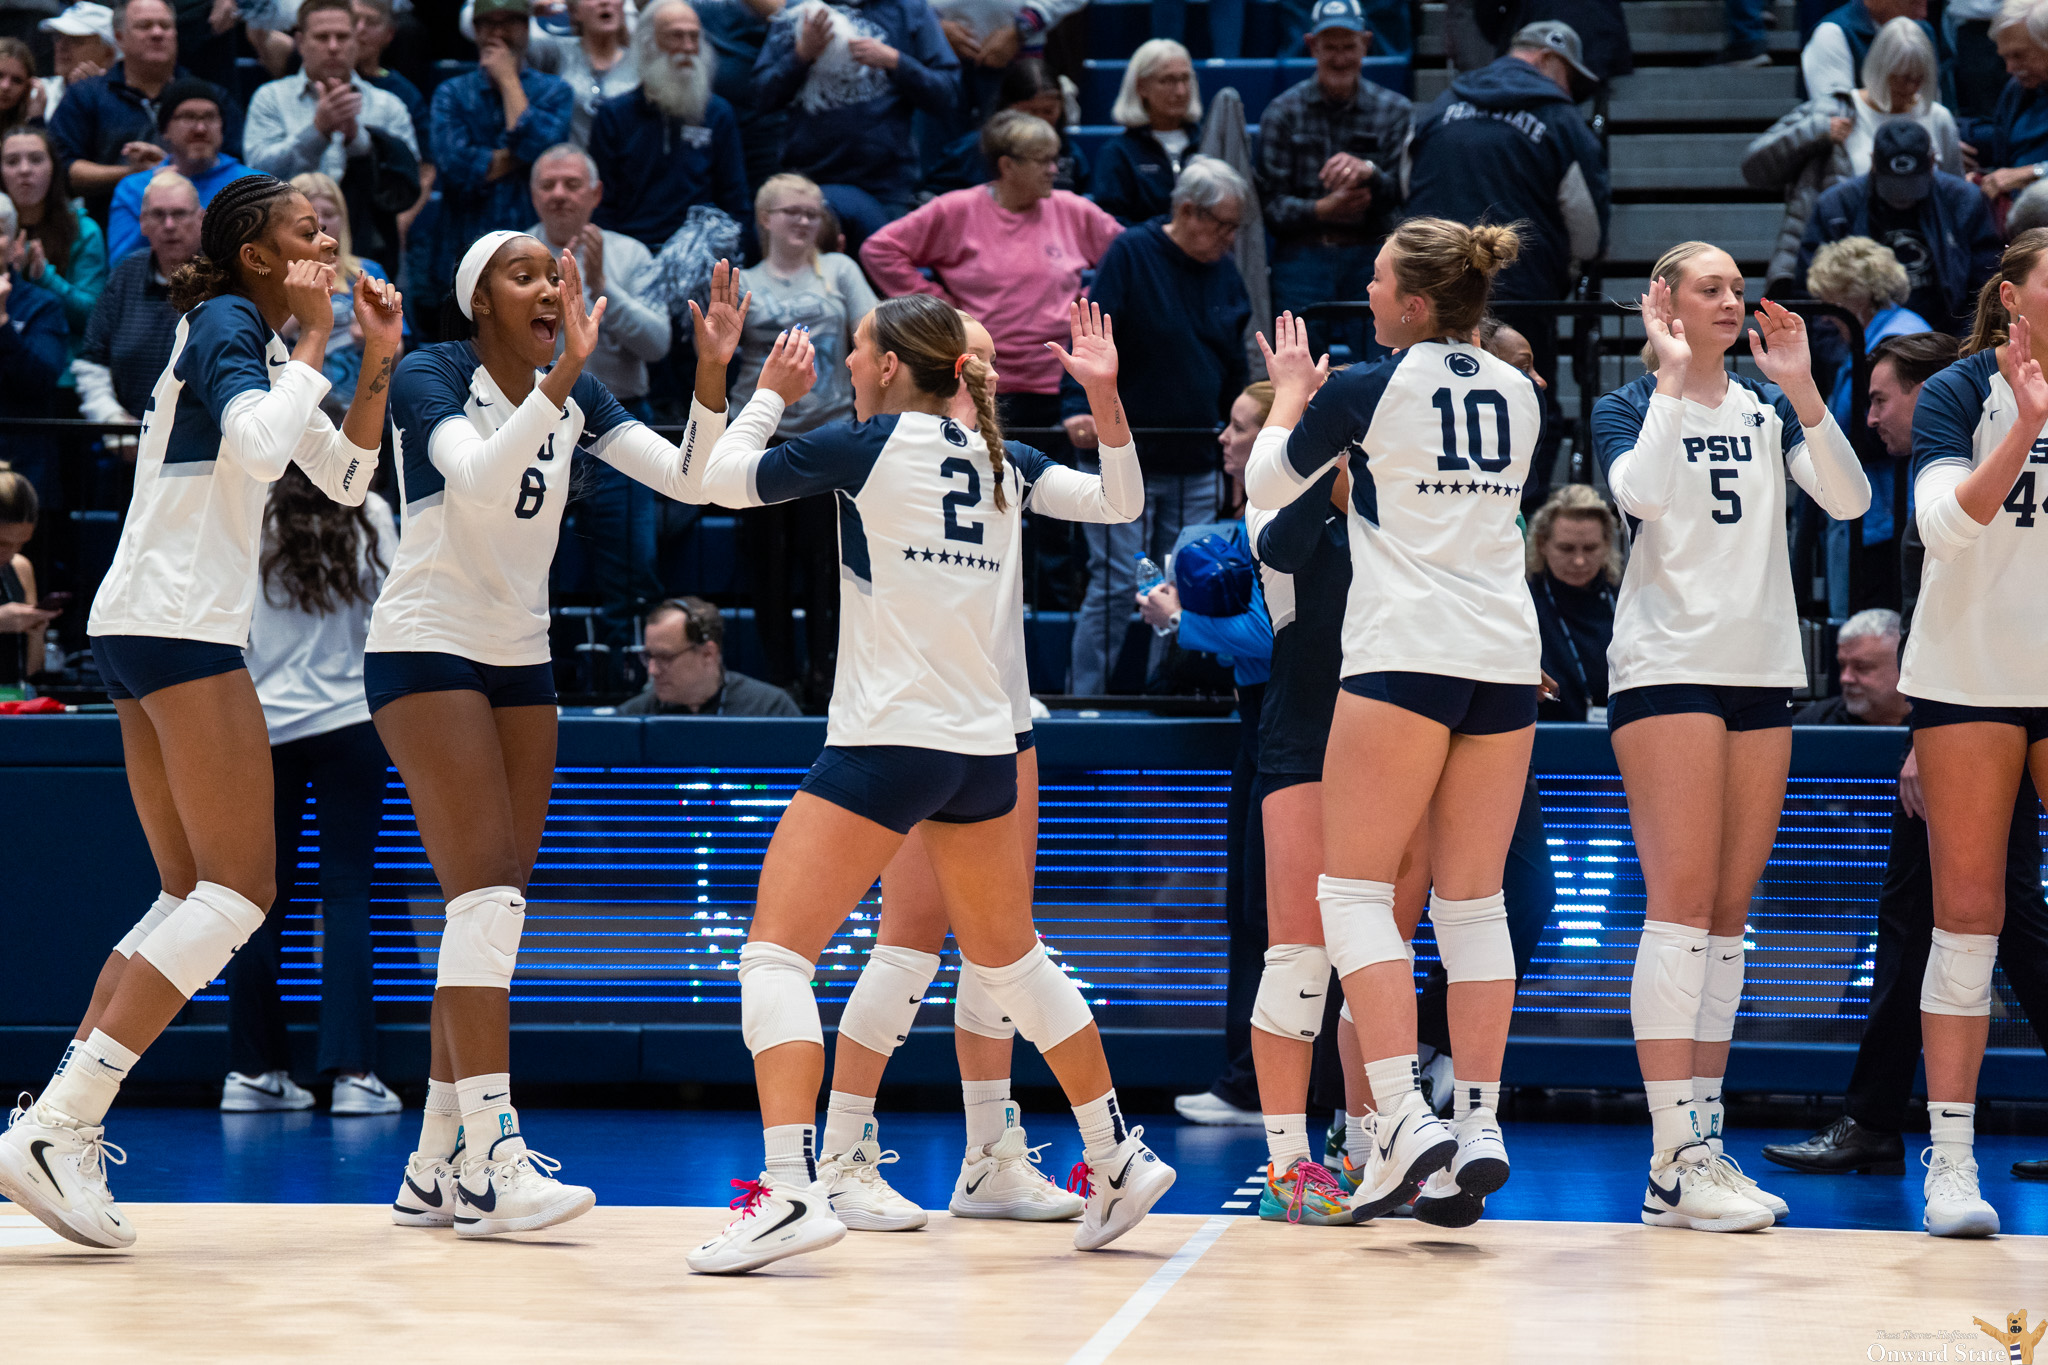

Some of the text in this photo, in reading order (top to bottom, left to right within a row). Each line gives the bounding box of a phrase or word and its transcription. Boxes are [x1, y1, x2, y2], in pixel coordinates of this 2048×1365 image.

[1431, 387, 1511, 473] 10
[1682, 435, 1752, 462] PSU
[514, 467, 547, 519] 8
[940, 456, 984, 545] 2
[1709, 468, 1742, 524] 5
[2003, 471, 2048, 527] 4
